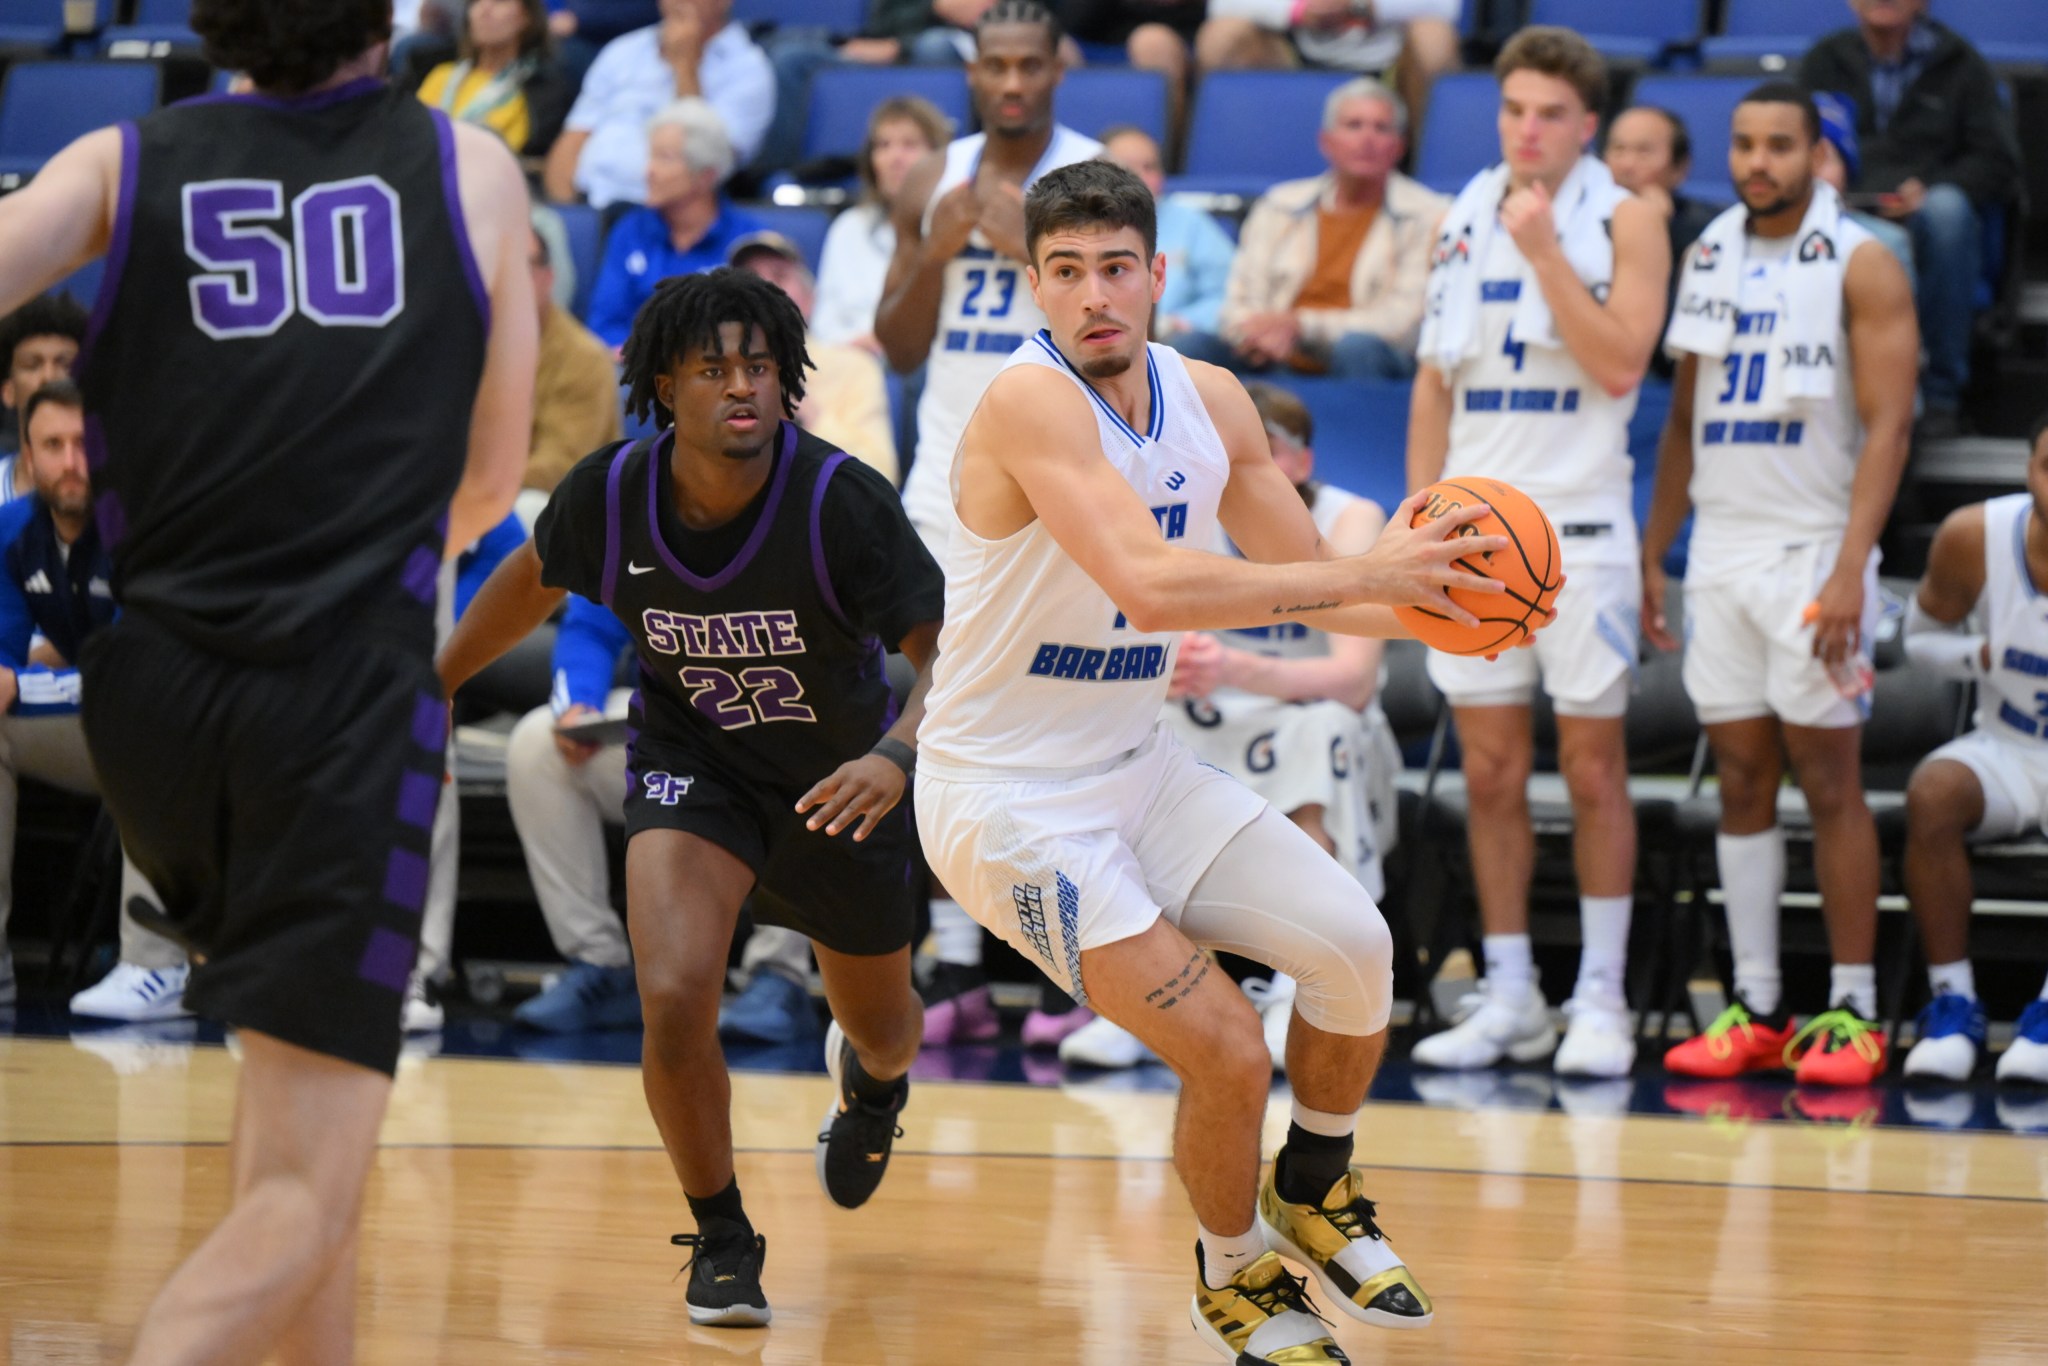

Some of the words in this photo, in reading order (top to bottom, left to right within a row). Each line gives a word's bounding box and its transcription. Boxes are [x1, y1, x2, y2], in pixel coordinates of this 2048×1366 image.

[182, 174, 405, 341] 50
[962, 269, 1018, 317] 23
[1502, 321, 1526, 372] 4
[1718, 352, 1767, 404] 30
[642, 608, 807, 658] STATE
[678, 666, 818, 730] 22
